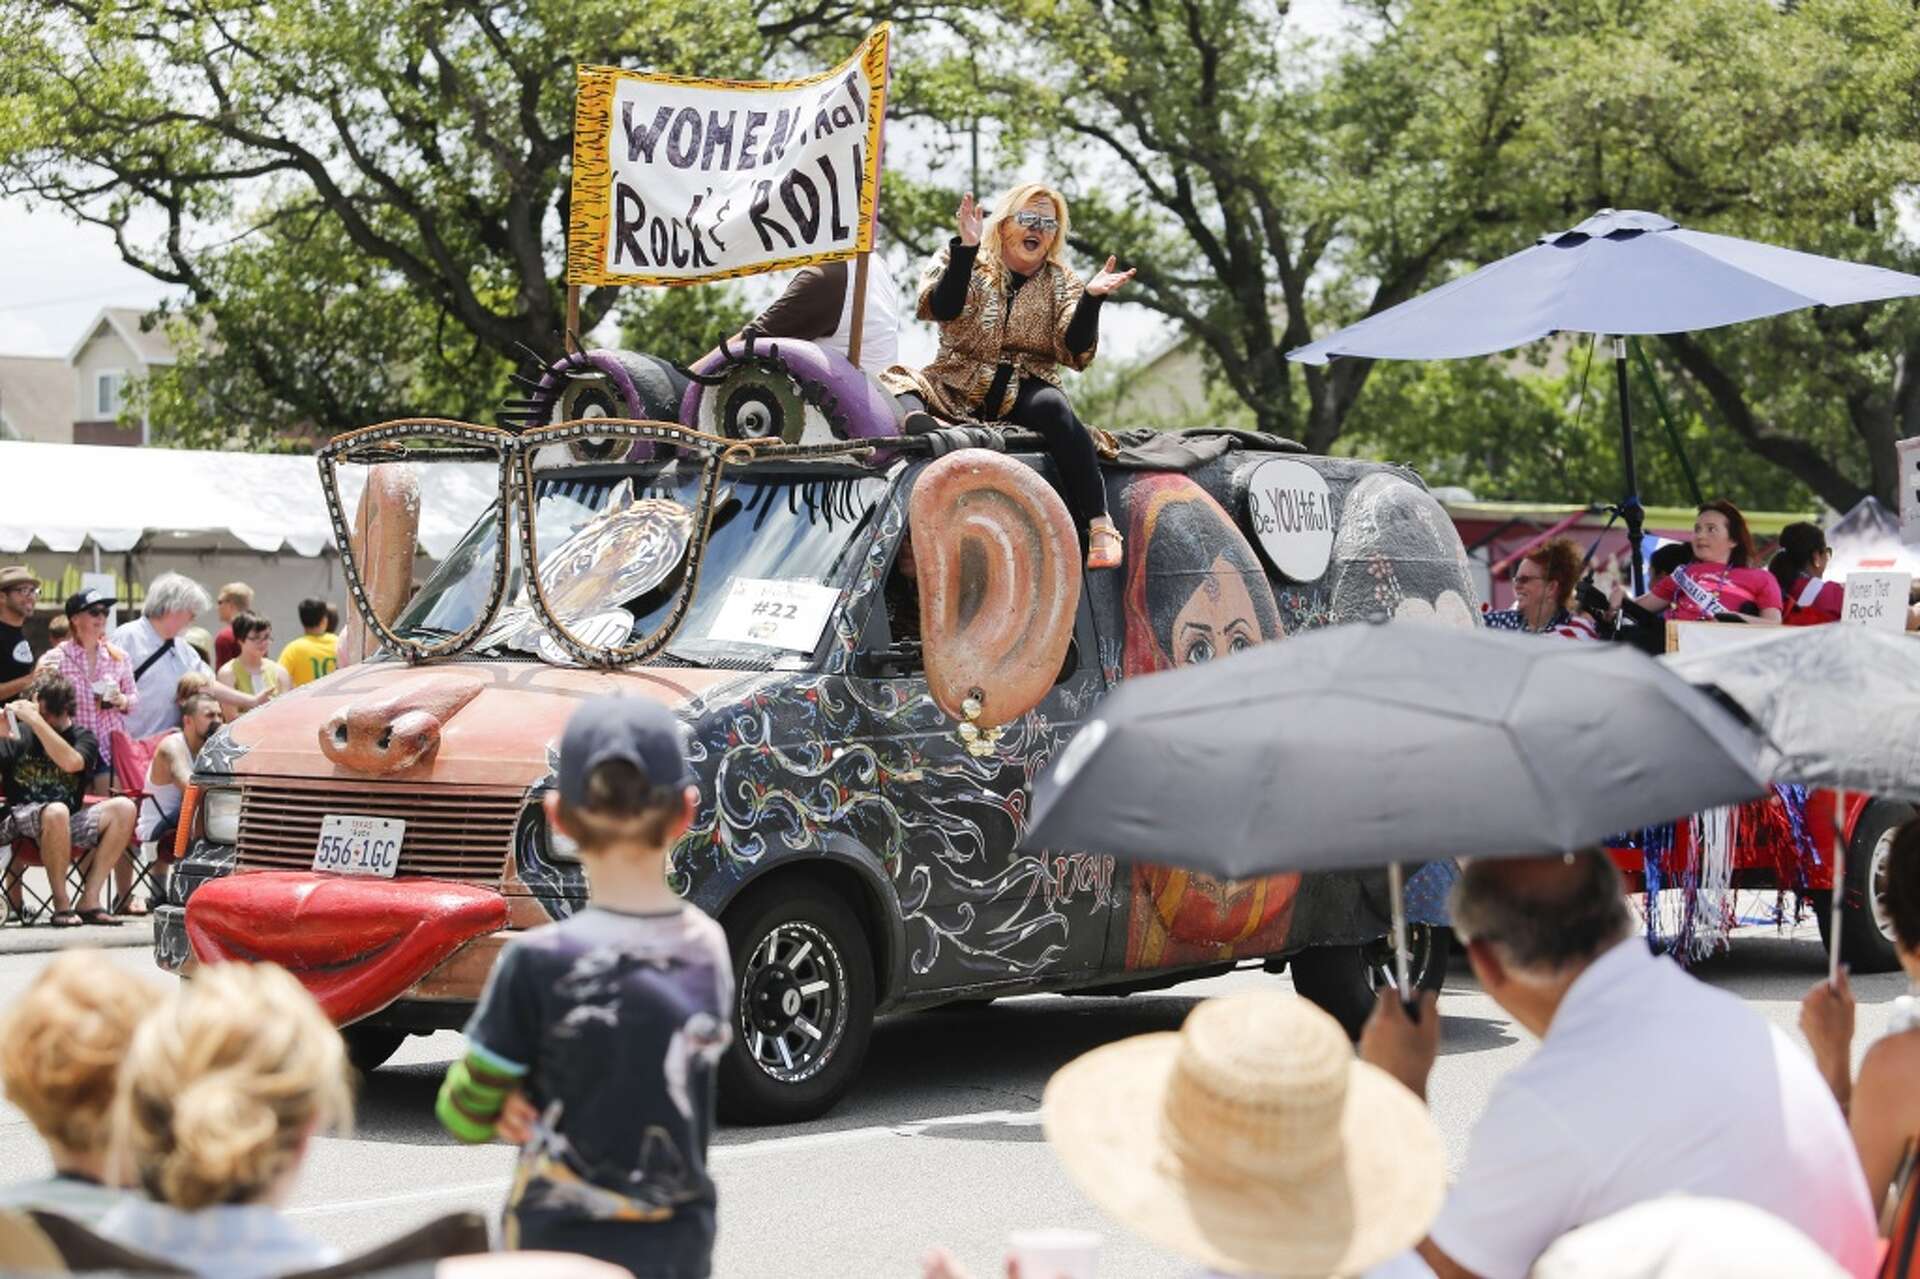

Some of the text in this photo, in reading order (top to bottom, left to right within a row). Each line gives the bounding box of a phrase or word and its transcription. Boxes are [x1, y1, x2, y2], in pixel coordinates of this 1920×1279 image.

[622, 101, 801, 171] WOMEN
[752, 601, 798, 619] #22
[1849, 600, 1884, 619] Rock
